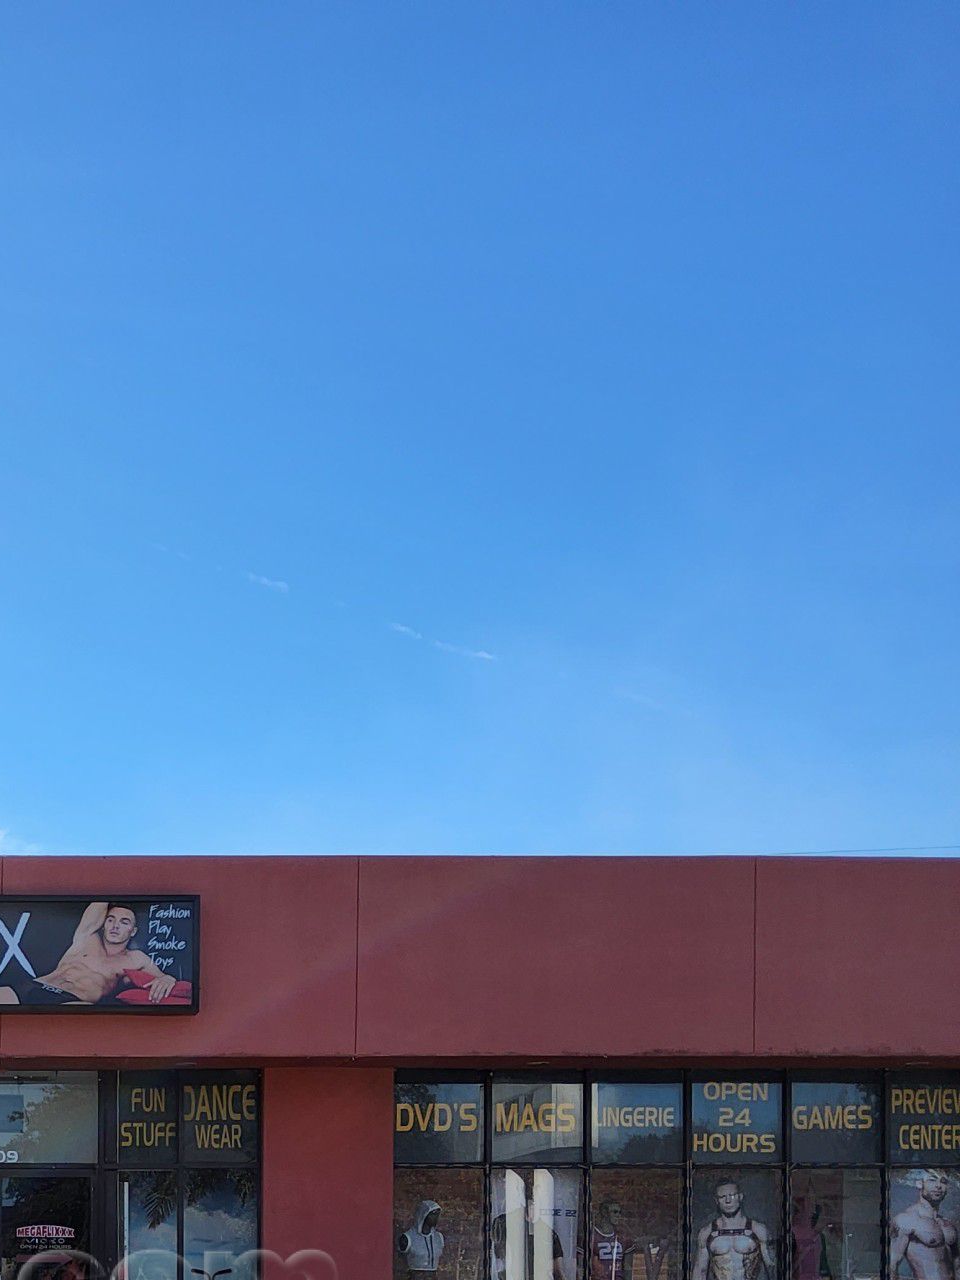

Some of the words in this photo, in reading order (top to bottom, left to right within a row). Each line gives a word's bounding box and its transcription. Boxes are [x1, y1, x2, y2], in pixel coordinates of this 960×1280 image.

[149, 904, 191, 918] Fashion
[148, 920, 172, 939] Play
[147, 936, 187, 950] Smoke
[148, 952, 174, 971] Toys
[131, 1088, 165, 1113] FUN
[704, 1082, 768, 1101] OPEN
[183, 1084, 256, 1120] DANCE
[396, 1103, 477, 1132] DVD'S
[496, 1103, 576, 1132] MAGS
[594, 1107, 675, 1127] LINGERIE
[718, 1107, 752, 1127] 24
[792, 1105, 873, 1130] GAMES
[120, 1122, 176, 1147] STUFF
[195, 1124, 241, 1148] WEAR
[693, 1133, 776, 1153] HOURS
[16, 1225, 75, 1238] MEGAFLIXXX
